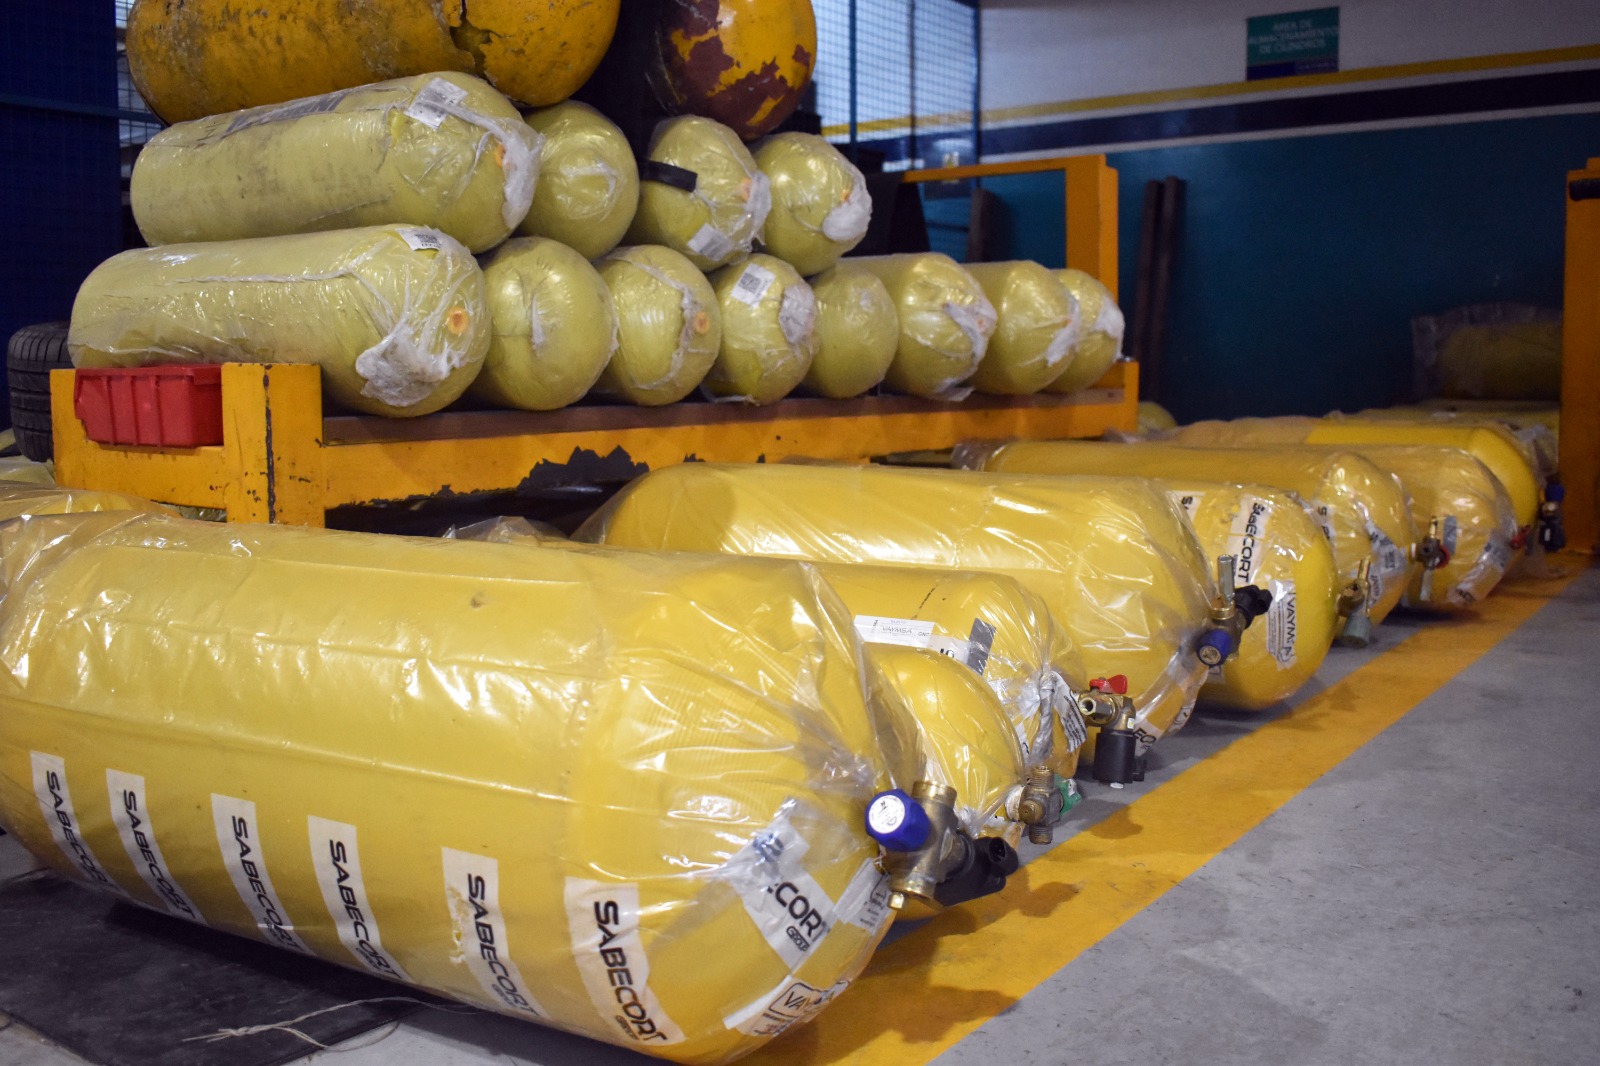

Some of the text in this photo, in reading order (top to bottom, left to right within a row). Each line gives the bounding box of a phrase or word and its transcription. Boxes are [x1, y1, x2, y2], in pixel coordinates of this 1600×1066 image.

[882, 626, 912, 634] VAYMSA
[46, 770, 111, 884] SABECOR
[123, 789, 196, 919] SABECORT
[232, 815, 305, 951] SABECORT
[329, 839, 402, 979] SABECORT
[467, 873, 539, 1016] SABECORT
[594, 900, 668, 1041] SABECORT
[786, 926, 810, 952] GROUP
